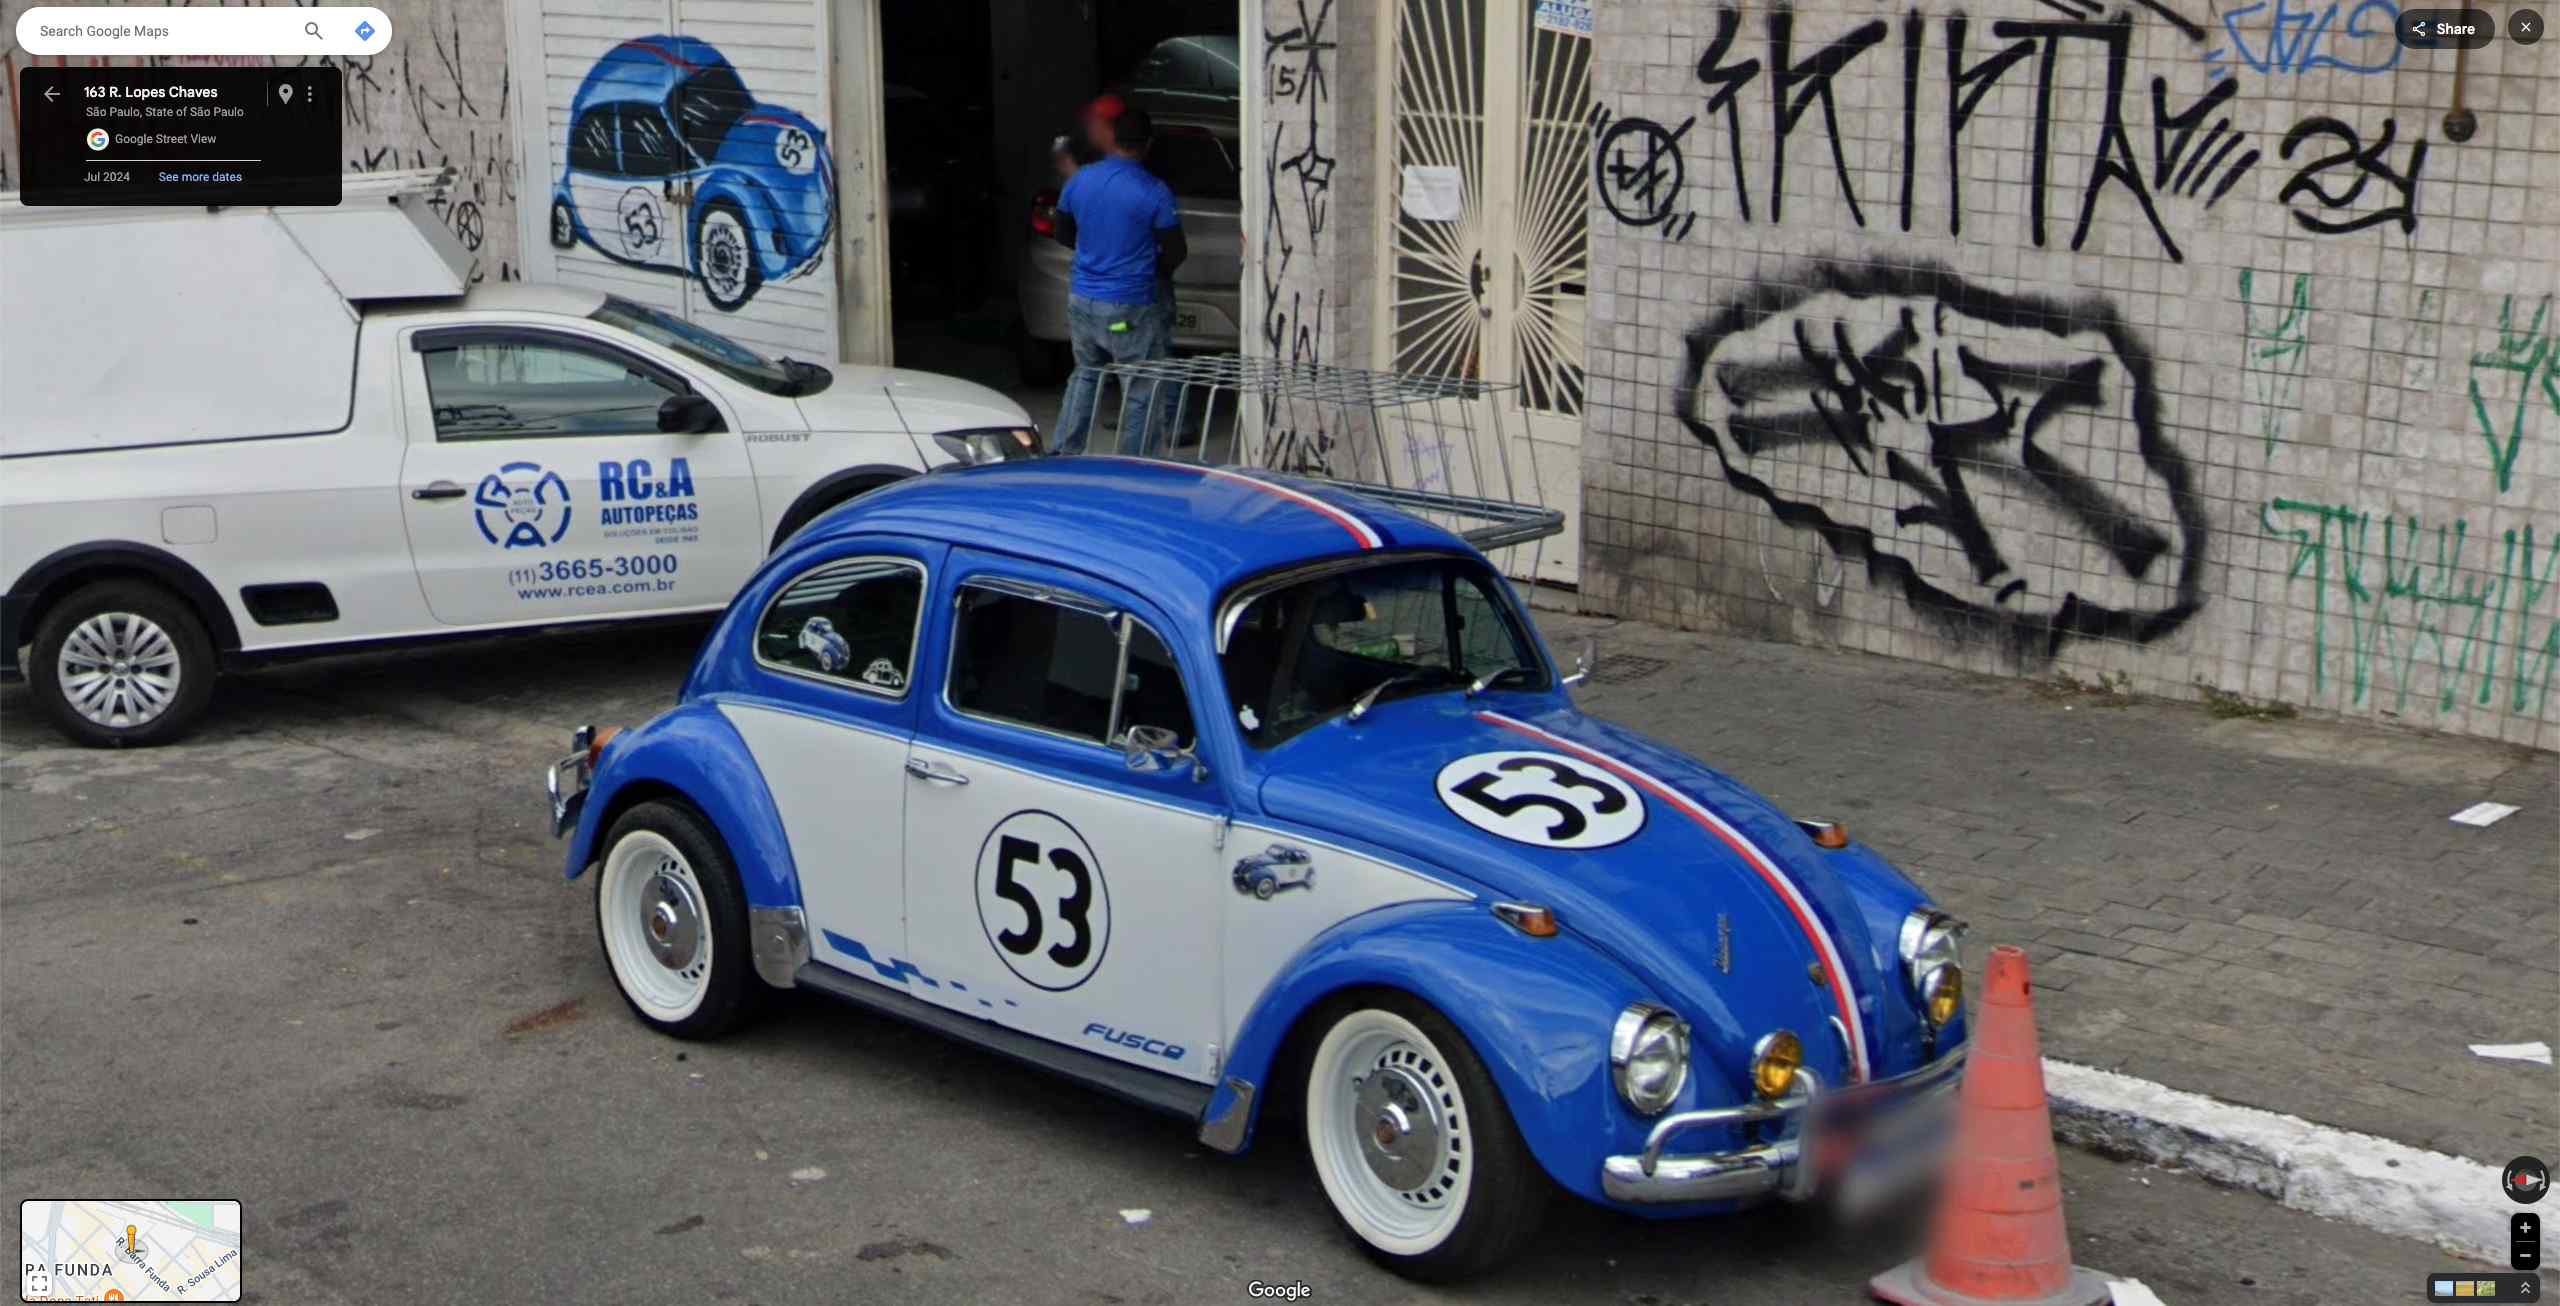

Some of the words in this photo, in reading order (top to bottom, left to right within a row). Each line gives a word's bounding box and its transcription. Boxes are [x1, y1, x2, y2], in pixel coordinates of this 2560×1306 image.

[781, 127, 808, 168] 53
[625, 202, 658, 249] 53
[746, 433, 812, 443] ROBUST
[599, 457, 696, 501] RC&A
[601, 502, 698, 526] AUTOPEÇAS
[508, 567, 537, 586] (11)
[539, 553, 678, 582] 3665-3000
[517, 578, 676, 600] www.rcea.com.br
[1449, 756, 1628, 841] 53
[995, 834, 1093, 968] 53
